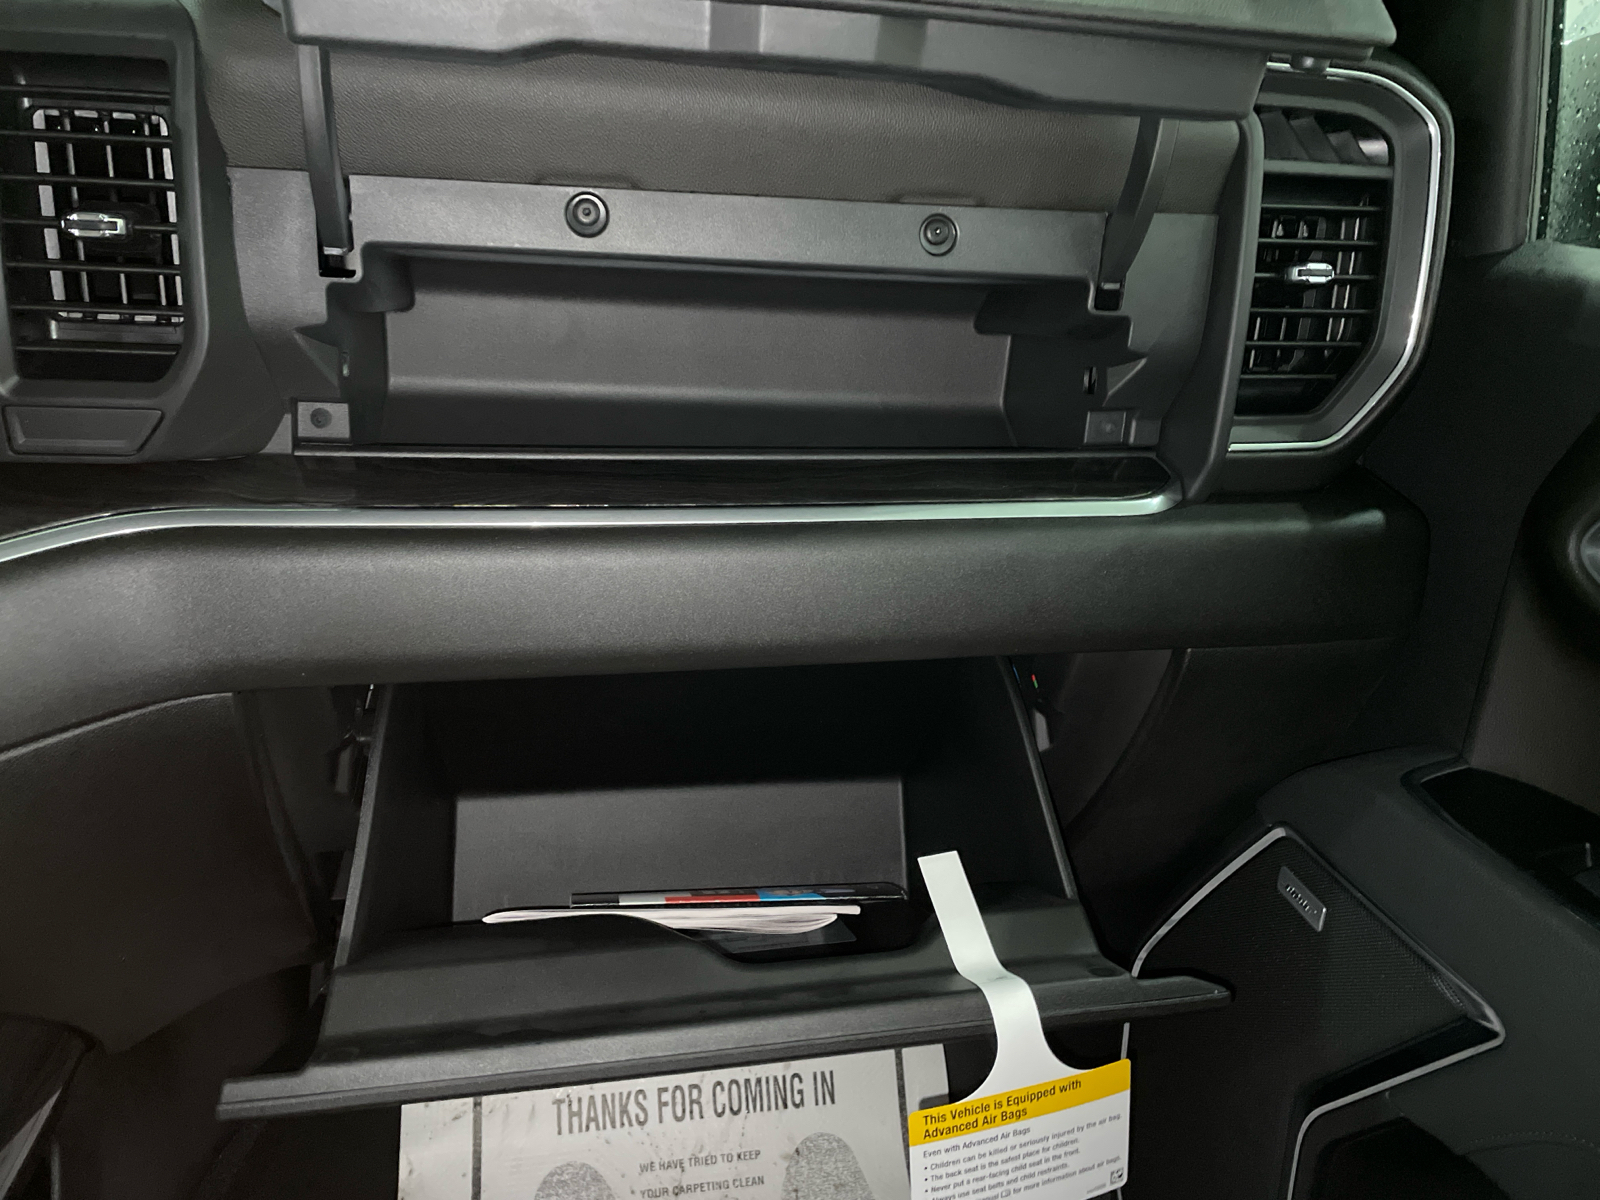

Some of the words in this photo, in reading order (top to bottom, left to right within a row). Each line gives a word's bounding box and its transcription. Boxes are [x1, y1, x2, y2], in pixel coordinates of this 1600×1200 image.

[552, 1088, 648, 1136] THANKS
[656, 1083, 704, 1124] FOR
[712, 1072, 804, 1118] COMING
[813, 1070, 836, 1106] IN
[922, 1112, 947, 1126] This
[950, 1102, 991, 1121] Vehicle
[993, 1098, 1003, 1110] is
[1006, 1085, 1056, 1106] Equipped
[1058, 1079, 1082, 1094] with
[923, 1118, 979, 1140] Advanced
[982, 1114, 998, 1128] Air
[1000, 1107, 1028, 1122] Bags
[923, 1148, 942, 1159] Even
[944, 1144, 960, 1154] with
[962, 1134, 999, 1150] Advanced
[1000, 1130, 1011, 1141] Air
[1012, 1126, 1031, 1138] Bags
[930, 1159, 961, 1171] Children
[962, 1155, 976, 1164] can
[978, 1152, 987, 1160] be
[988, 1146, 1008, 1157] killed
[1019, 1133, 1050, 1149] seriously
[1051, 1127, 1075, 1140] injured
[1076, 1124, 1085, 1133] by
[1086, 1120, 1097, 1129] the
[1098, 1118, 1107, 1126] air
[639, 1162, 656, 1174] WE
[658, 1157, 686, 1171] HAVE
[688, 1154, 718, 1168] TRIED
[721, 1152, 734, 1163] TO
[736, 1150, 761, 1162] KEEP
[930, 1184, 952, 1194] Never
[953, 1180, 965, 1190] put
[972, 1168, 1010, 1183] rear-facing
[1010, 1162, 1027, 1173] child
[1028, 1159, 1043, 1168] seat
[1044, 1156, 1051, 1164] in
[1052, 1154, 1062, 1162] the
[931, 1174, 944, 1182] The
[945, 1170, 962, 1179] back
[964, 1164, 979, 1174] seat
[980, 1162, 987, 1170] is
[988, 1160, 999, 1168] the
[1000, 1154, 1020, 1165] safest
[1022, 1149, 1040, 1160] place
[1042, 1145, 1051, 1154] for
[640, 1186, 670, 1200] YOUR
[672, 1180, 730, 1196] CARPETING
[732, 1175, 764, 1188] CLEAN
[958, 1190, 970, 1198] use
[972, 1186, 987, 1195] seat
[988, 1180, 1005, 1191] belts
[1006, 1176, 1019, 1186] and
[1020, 1172, 1036, 1182] child
